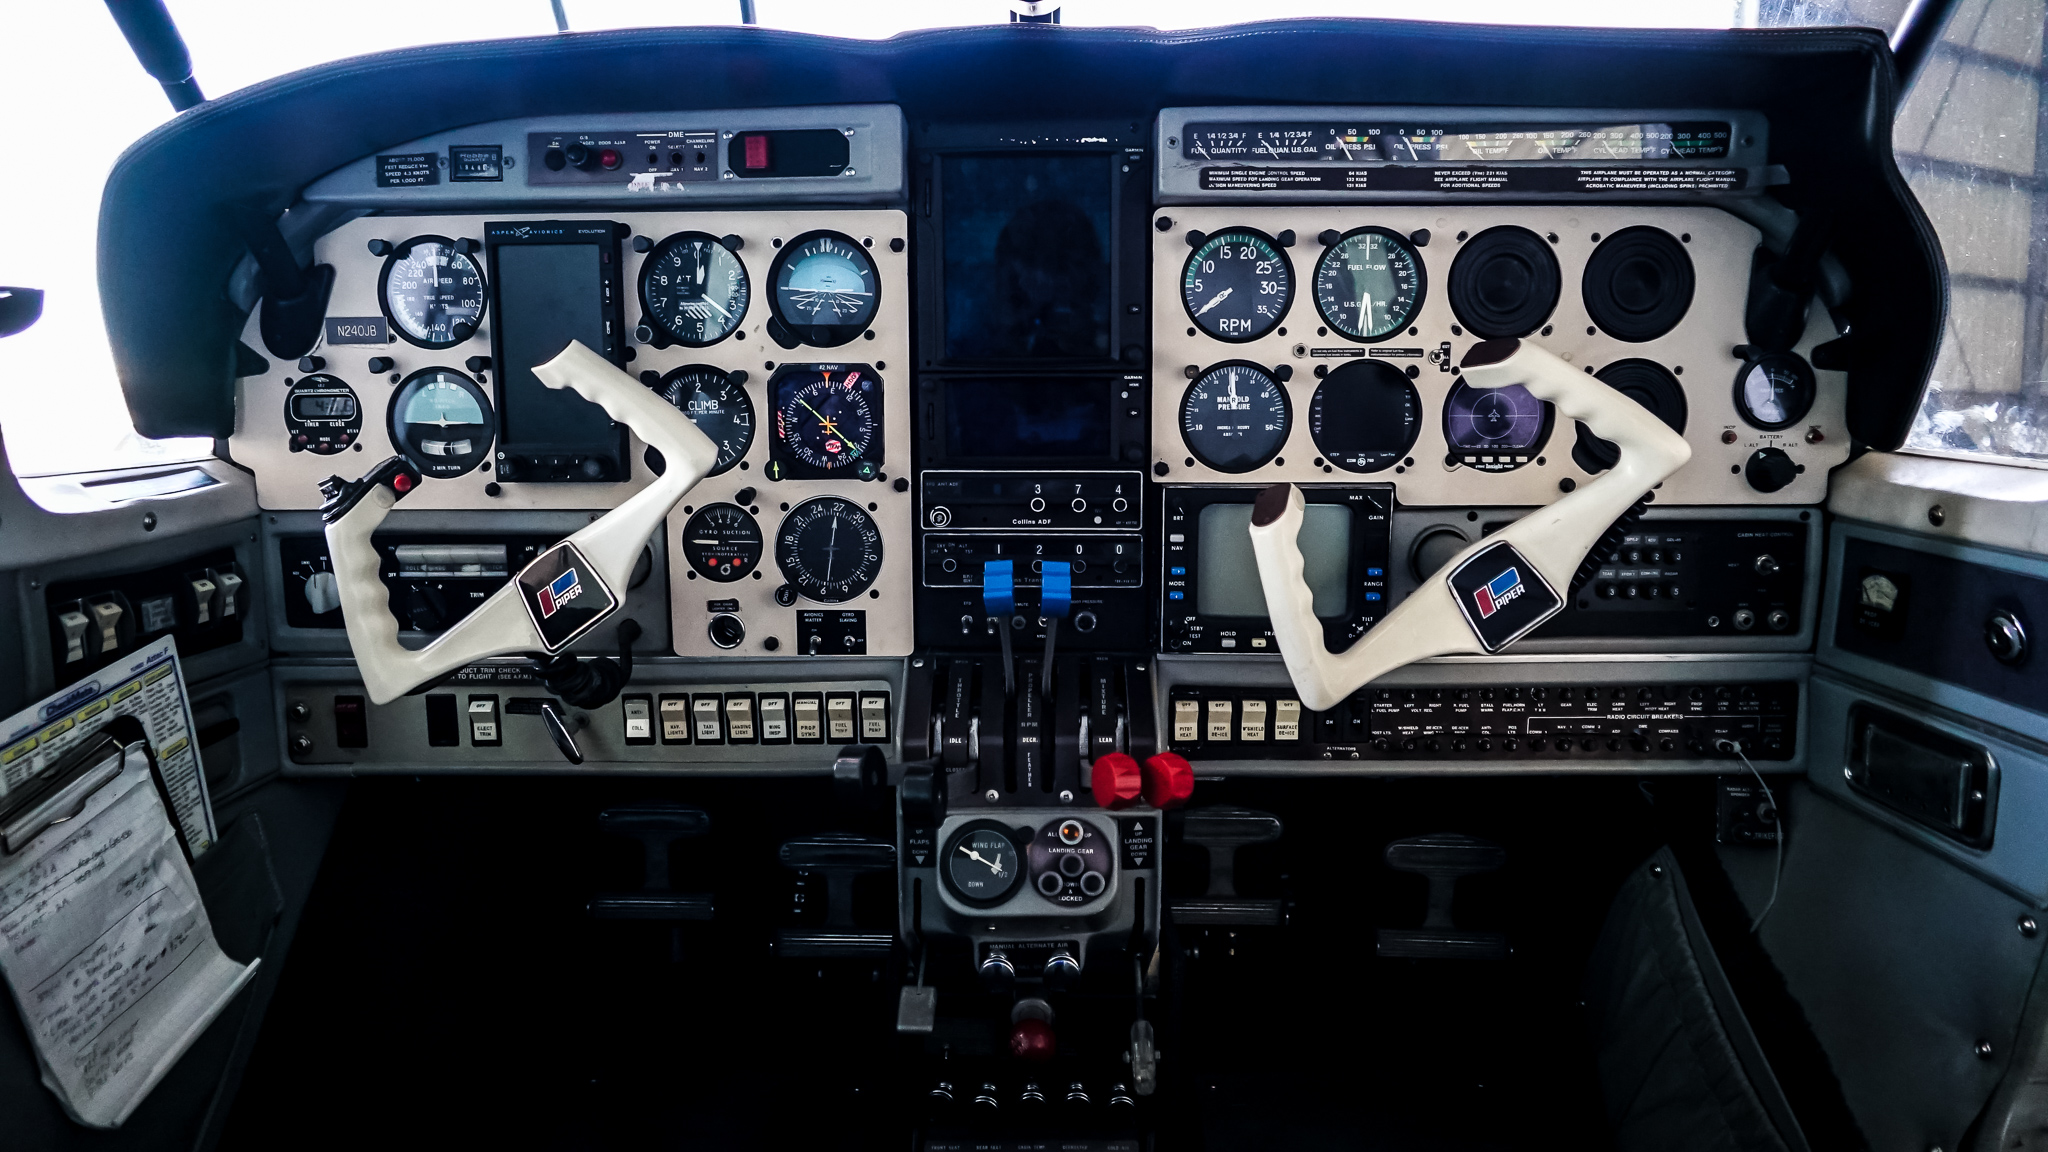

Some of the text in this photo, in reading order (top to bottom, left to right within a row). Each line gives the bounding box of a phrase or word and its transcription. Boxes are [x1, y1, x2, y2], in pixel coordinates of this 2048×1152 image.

[1220, 245, 1232, 259] 15
[1240, 246, 1257, 260] 20
[411, 261, 427, 269] 240
[451, 261, 463, 269] 60
[673, 256, 682, 267] 9
[1202, 260, 1215, 274] 10
[1255, 261, 1272, 274] 25
[408, 269, 424, 277] 220
[728, 270, 736, 280] 2
[402, 281, 417, 289] 200
[462, 277, 474, 285] 80
[660, 275, 668, 286] 8
[1194, 279, 1203, 292] 5
[1259, 281, 1278, 295] 30
[461, 299, 476, 308] 100
[660, 297, 668, 307] 7
[729, 300, 737, 310] 3
[1256, 305, 1268, 314] 35
[674, 315, 683, 326] 6
[1219, 318, 1252, 332] RPM
[337, 324, 377, 337] N240JB
[431, 323, 446, 332] 140
[696, 322, 704, 333] 5
[695, 383, 702, 393] 2
[720, 391, 727, 401] 3
[688, 400, 719, 411] CLIMB
[733, 415, 741, 424] 4
[723, 440, 730, 450] 3
[1034, 484, 1042, 494] 3
[1075, 484, 1082, 494] 7
[1115, 484, 1122, 494] 4
[810, 504, 823, 514] 24
[833, 502, 846, 512] 27
[793, 515, 805, 526] 21
[852, 511, 866, 523] 30
[784, 535, 794, 545] 18
[866, 530, 877, 542] 33
[1036, 544, 1043, 555] 2
[1076, 544, 1083, 555] 0
[1116, 544, 1122, 555] 0
[785, 557, 795, 567] 15
[798, 576, 808, 587] 12
[554, 584, 583, 610] PIPER
[1494, 584, 1526, 610] PIPER
